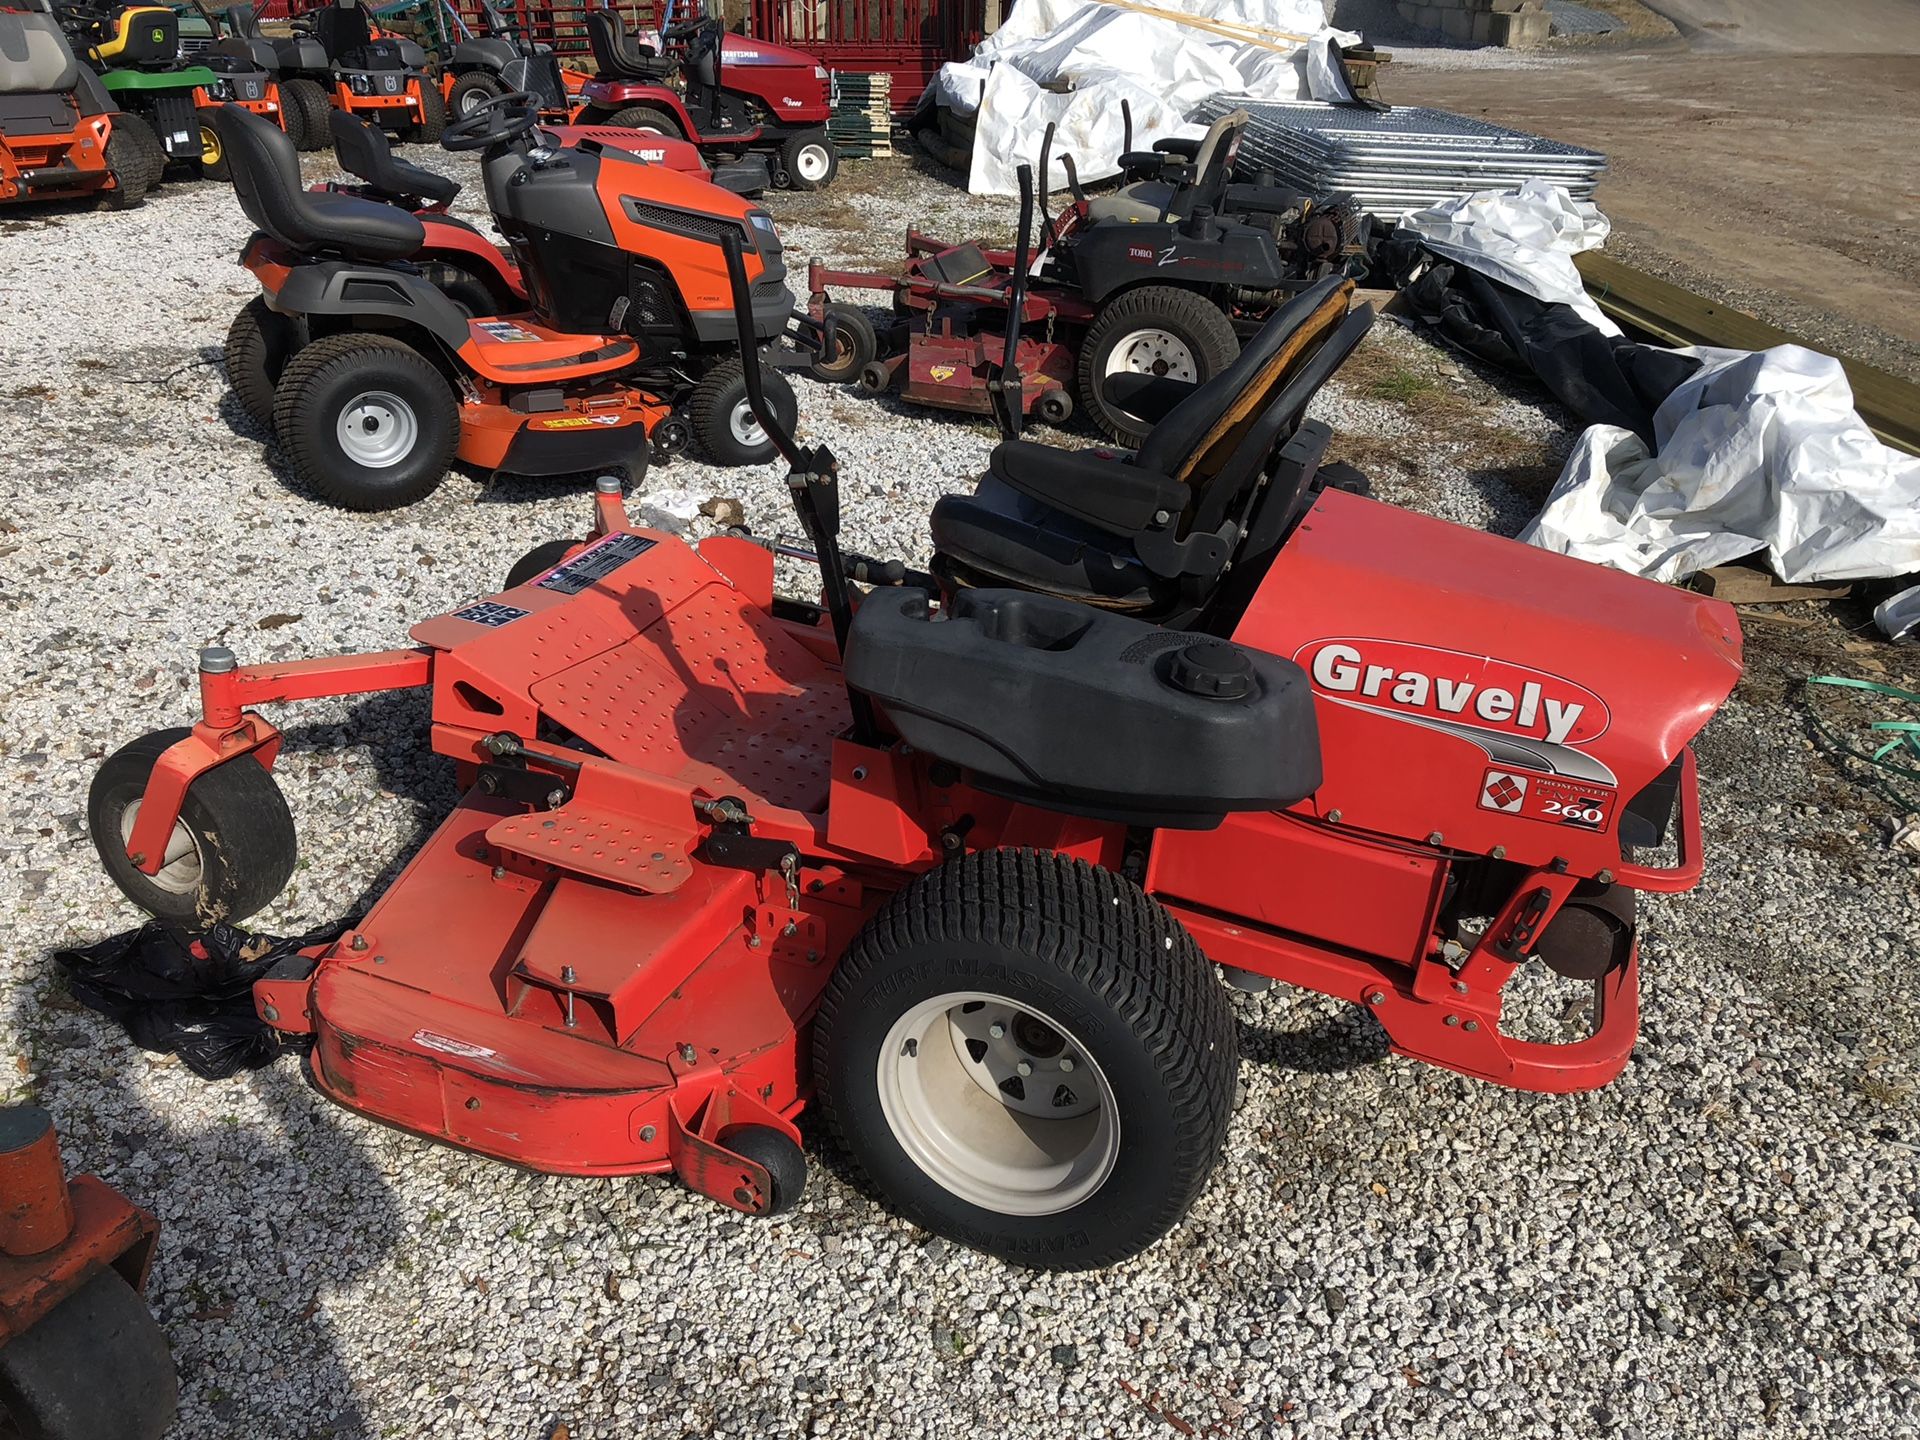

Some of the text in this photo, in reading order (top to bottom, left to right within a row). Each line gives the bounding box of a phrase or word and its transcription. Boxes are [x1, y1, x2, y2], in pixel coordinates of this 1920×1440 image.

[1311, 643, 1586, 746] Gravely
[1535, 778, 1610, 798] PROMASTER
[1540, 799, 1604, 823] 260
[943, 956, 1105, 1038] MASTER
